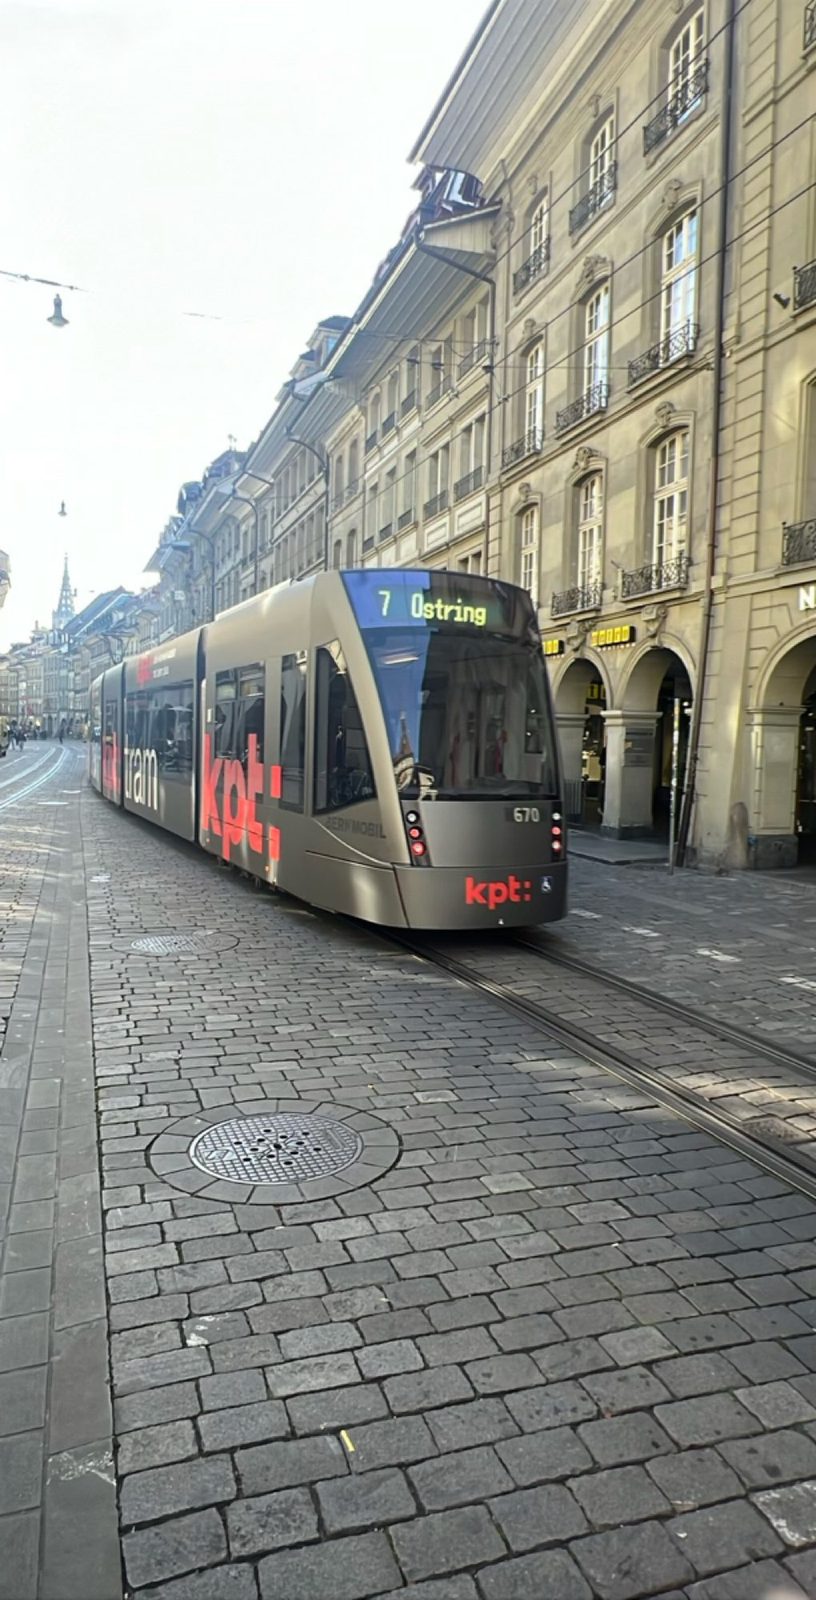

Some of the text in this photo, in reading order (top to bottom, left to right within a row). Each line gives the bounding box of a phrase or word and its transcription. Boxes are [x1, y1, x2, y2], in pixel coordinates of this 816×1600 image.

[378, 589, 487, 626] 7 Ostring
[124, 733, 158, 811] tram
[513, 807, 541, 824] 670
[465, 875, 533, 910] kpt:
